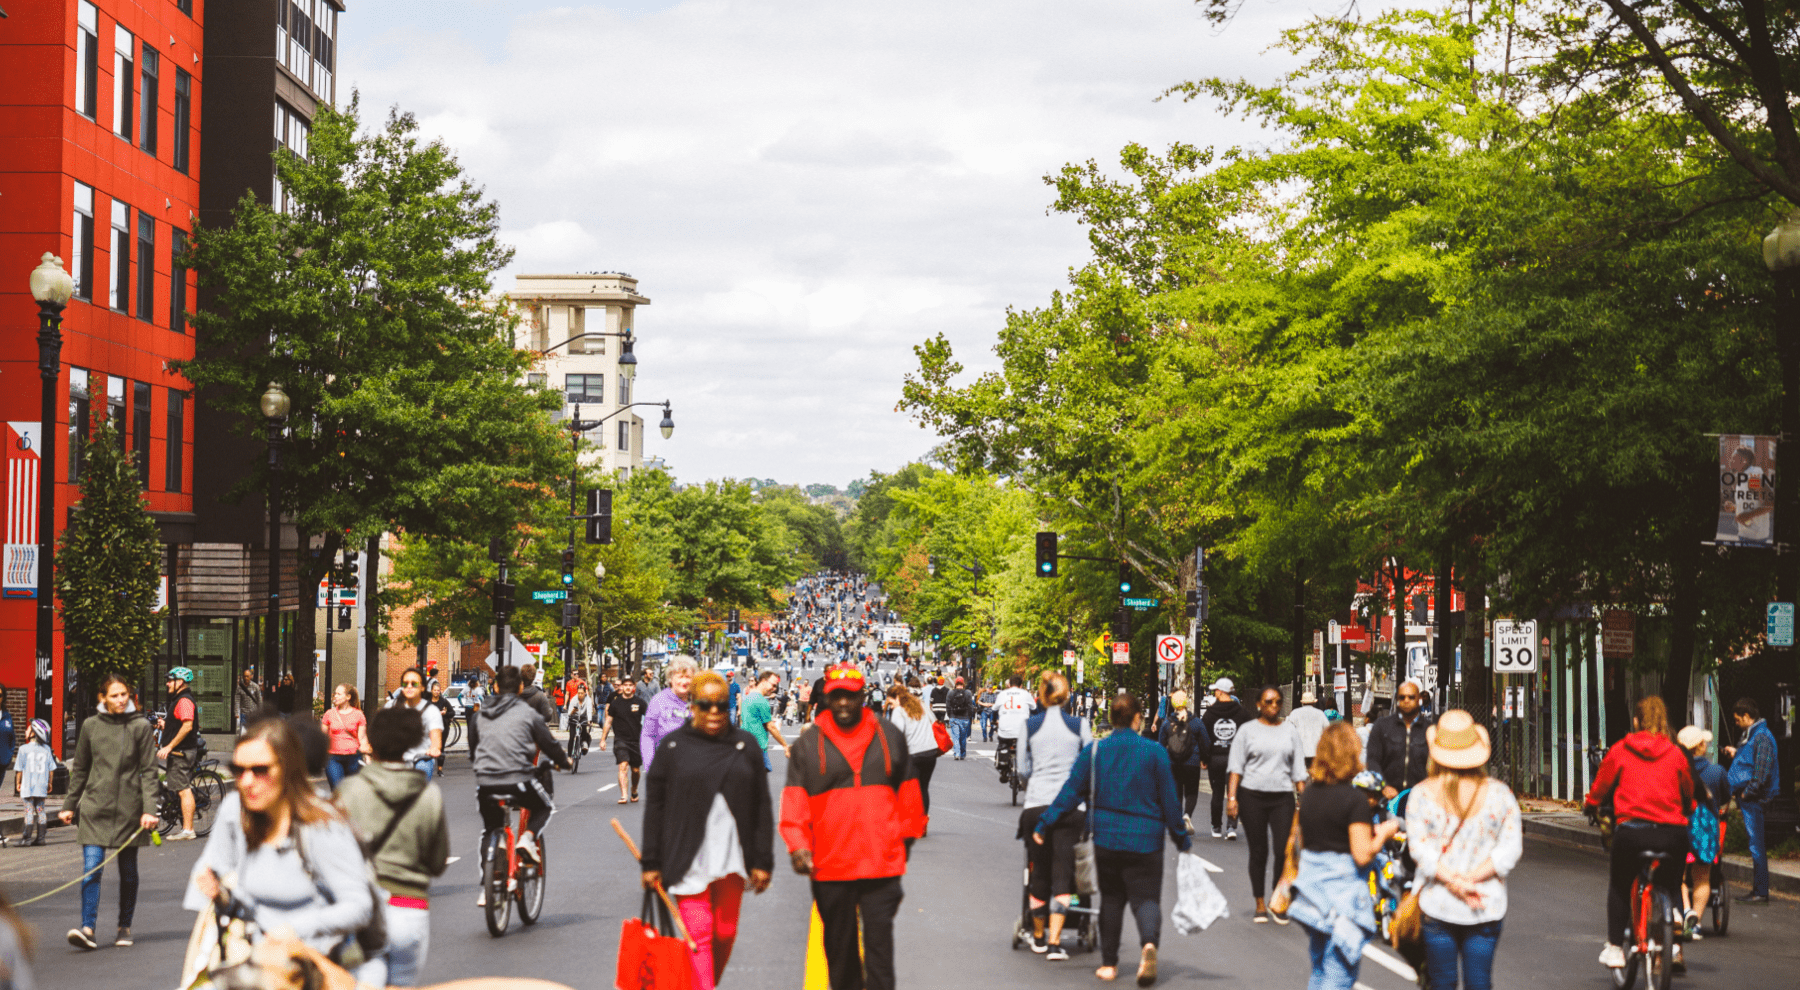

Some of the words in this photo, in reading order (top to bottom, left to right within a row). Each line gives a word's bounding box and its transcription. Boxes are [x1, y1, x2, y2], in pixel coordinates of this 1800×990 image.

[1722, 490, 1774, 500] STREETS
[1742, 502, 1755, 510] DC
[533, 591, 559, 599] Shepherd
[1126, 598, 1151, 606] Shepherd
[1498, 626, 1532, 634] SPEED
[1501, 637, 1528, 645] LIMIT
[1499, 647, 1532, 666] 30
[1428, 676, 1439, 684] WA
[27, 751, 47, 774] 13
